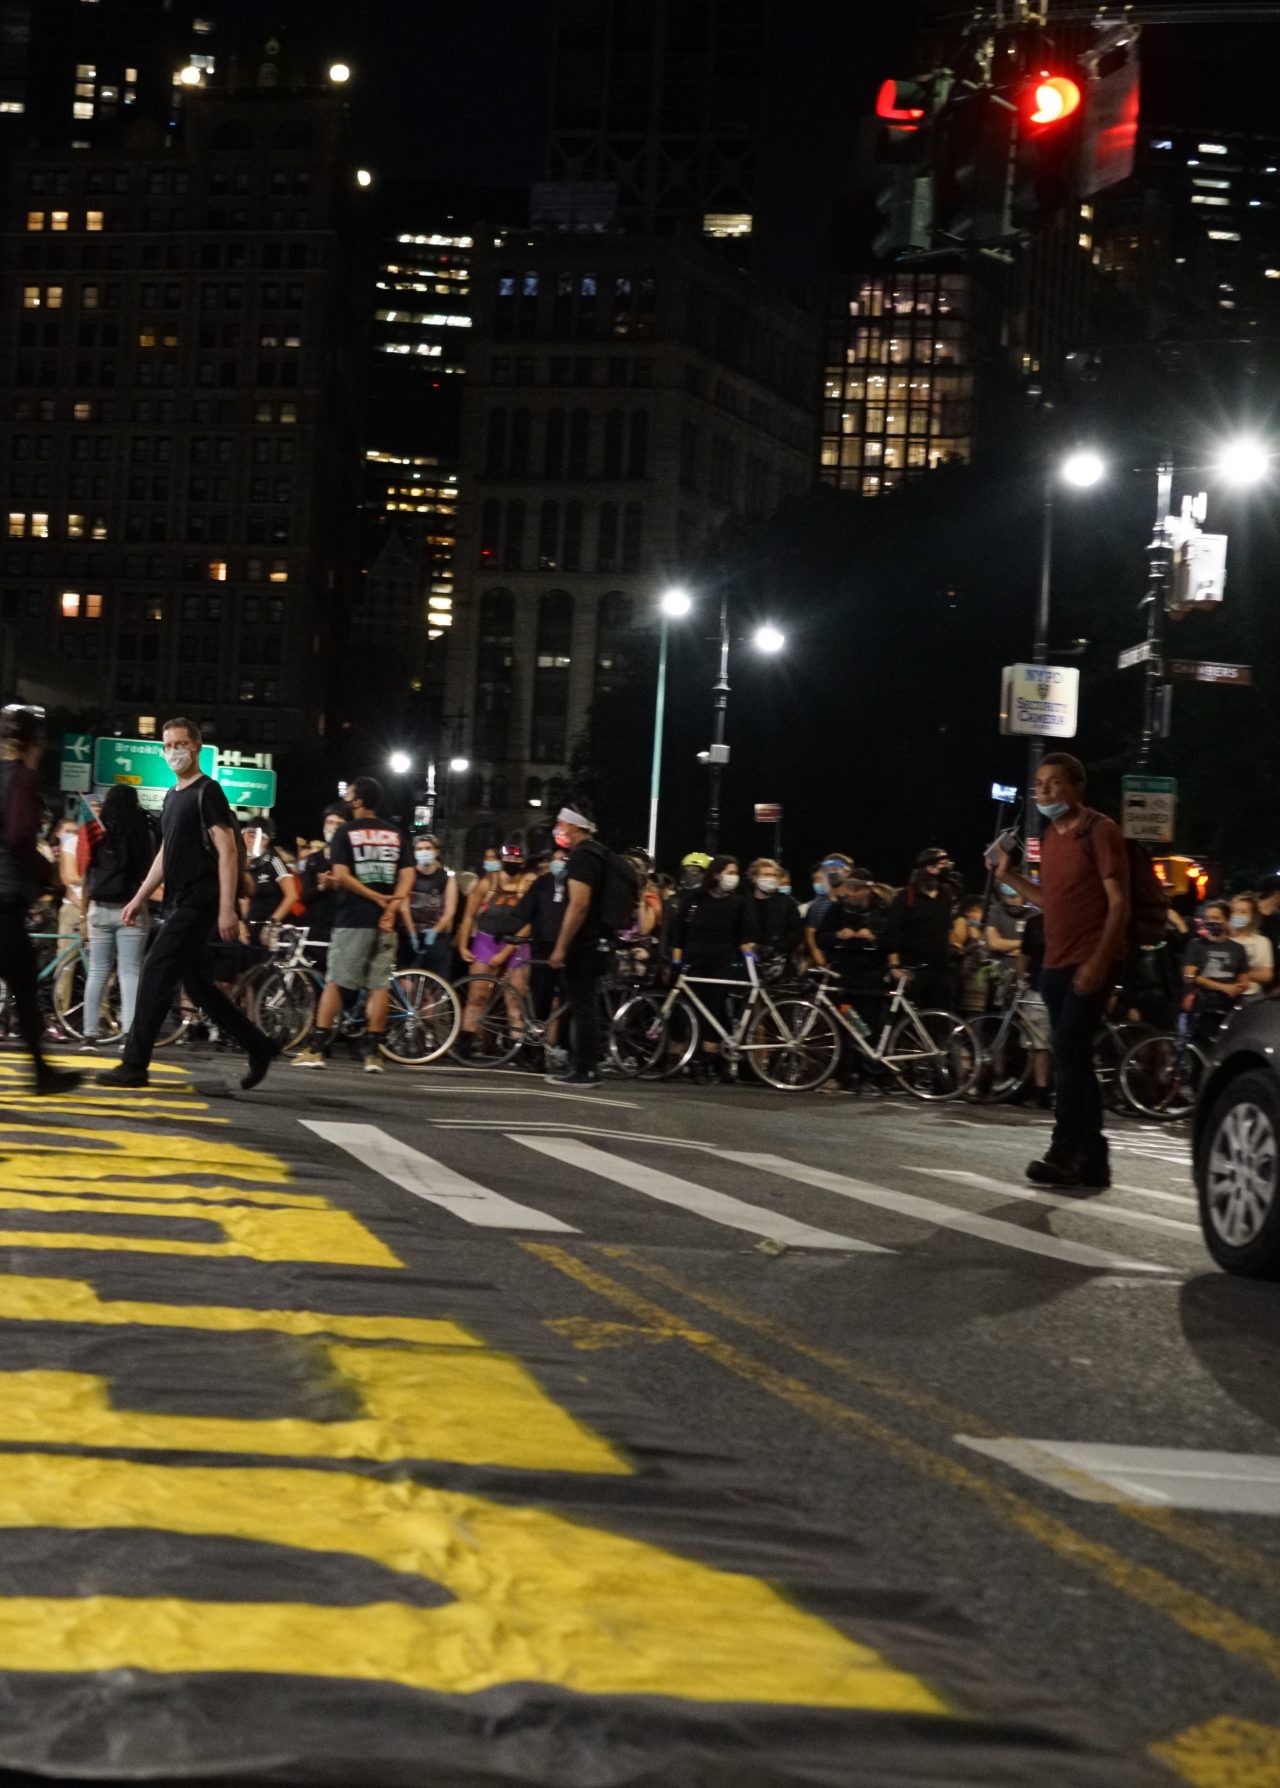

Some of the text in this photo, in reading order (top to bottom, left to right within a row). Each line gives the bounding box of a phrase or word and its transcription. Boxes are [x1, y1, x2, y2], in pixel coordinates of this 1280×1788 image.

[115, 743, 165, 757] Brookly
[348, 829, 400, 847] BLACK
[353, 846, 400, 861] LIVES
